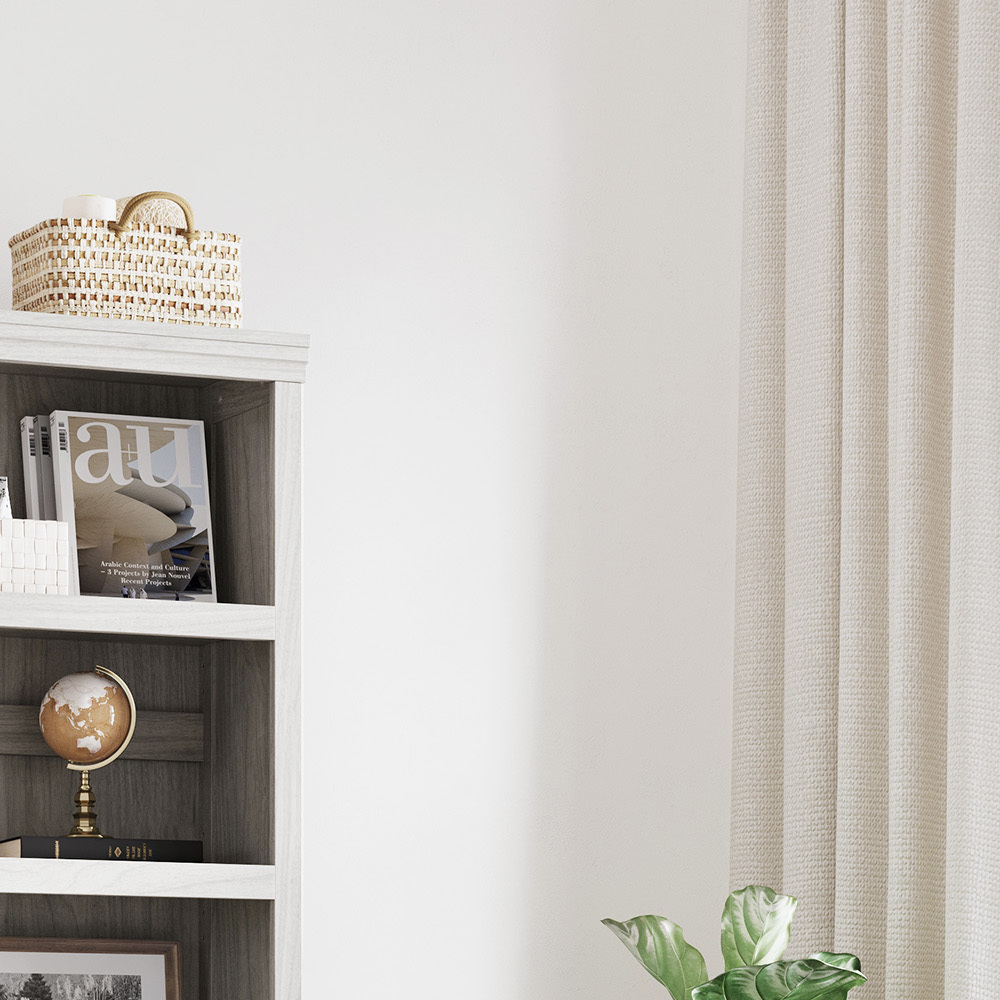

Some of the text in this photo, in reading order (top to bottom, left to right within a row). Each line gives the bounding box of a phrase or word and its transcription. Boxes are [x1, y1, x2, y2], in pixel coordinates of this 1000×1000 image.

[164, 564, 190, 572] Culture
[113, 569, 140, 577] Projects
[142, 570, 149, 578] by
[168, 572, 191, 580] Nouvel
[120, 577, 172, 587] Recent Projects
